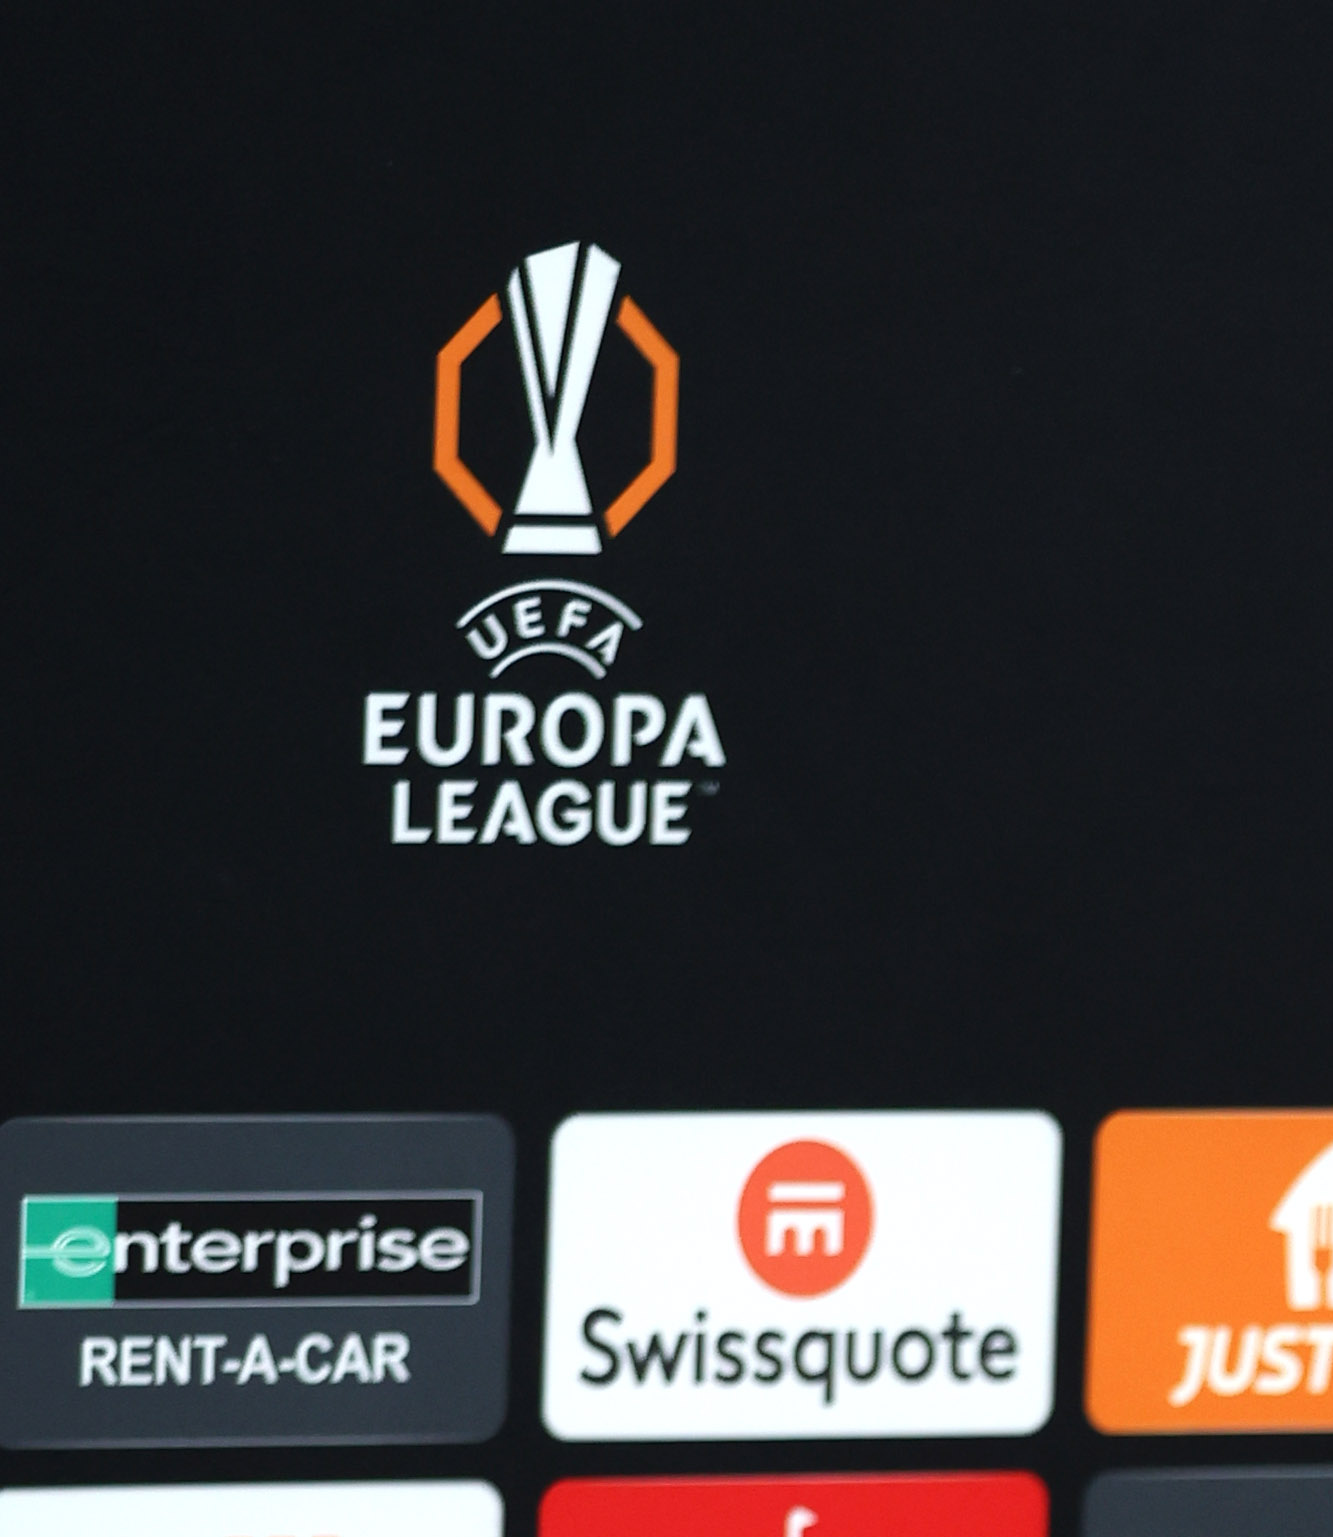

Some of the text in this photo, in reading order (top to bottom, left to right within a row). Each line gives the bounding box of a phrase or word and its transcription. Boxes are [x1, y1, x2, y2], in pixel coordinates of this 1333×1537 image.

[467, 597, 626, 665] UEFA
[362, 692, 726, 768] EUROPA
[391, 779, 692, 846] LEAGUE
[50, 1214, 470, 1288] enterprise
[79, 1332, 411, 1387] RENT-A-CAR
[579, 1306, 1019, 1406] Swissquote
